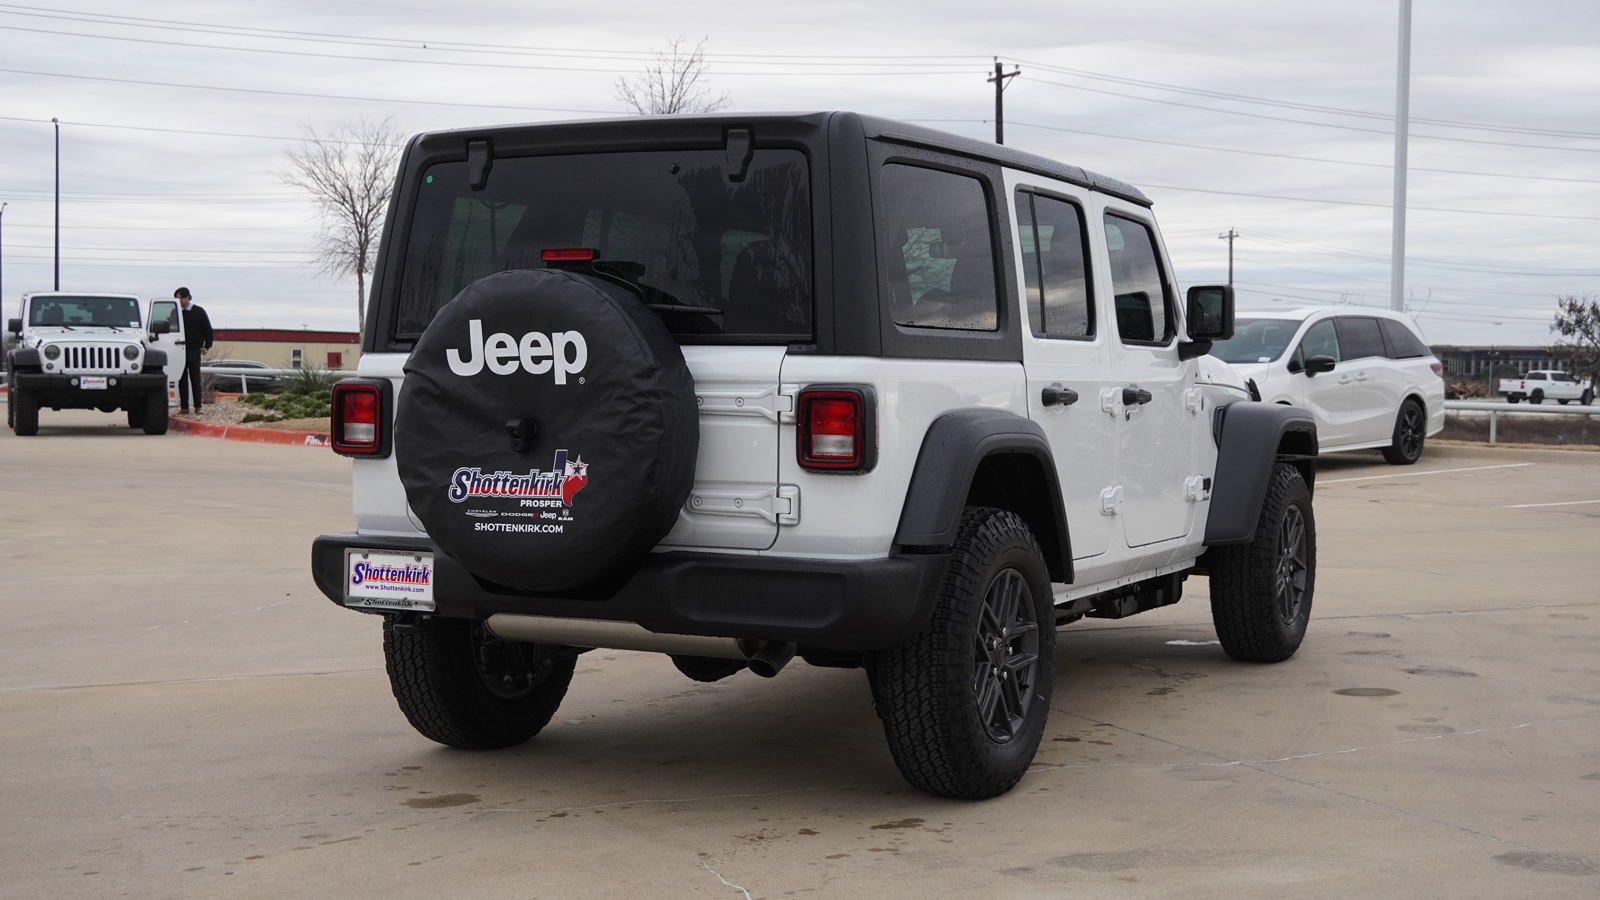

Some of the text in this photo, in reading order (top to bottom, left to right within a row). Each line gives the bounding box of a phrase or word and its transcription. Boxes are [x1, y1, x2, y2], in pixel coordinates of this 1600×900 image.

[446, 319, 587, 385] Jeep
[449, 467, 562, 502] Shottenkirk
[540, 511, 557, 519] Jeep
[474, 523, 564, 533] SHOTTENKIRK.COM
[352, 561, 431, 585] Shottenkirk
[365, 584, 424, 593] www.Shottenkirk.com
